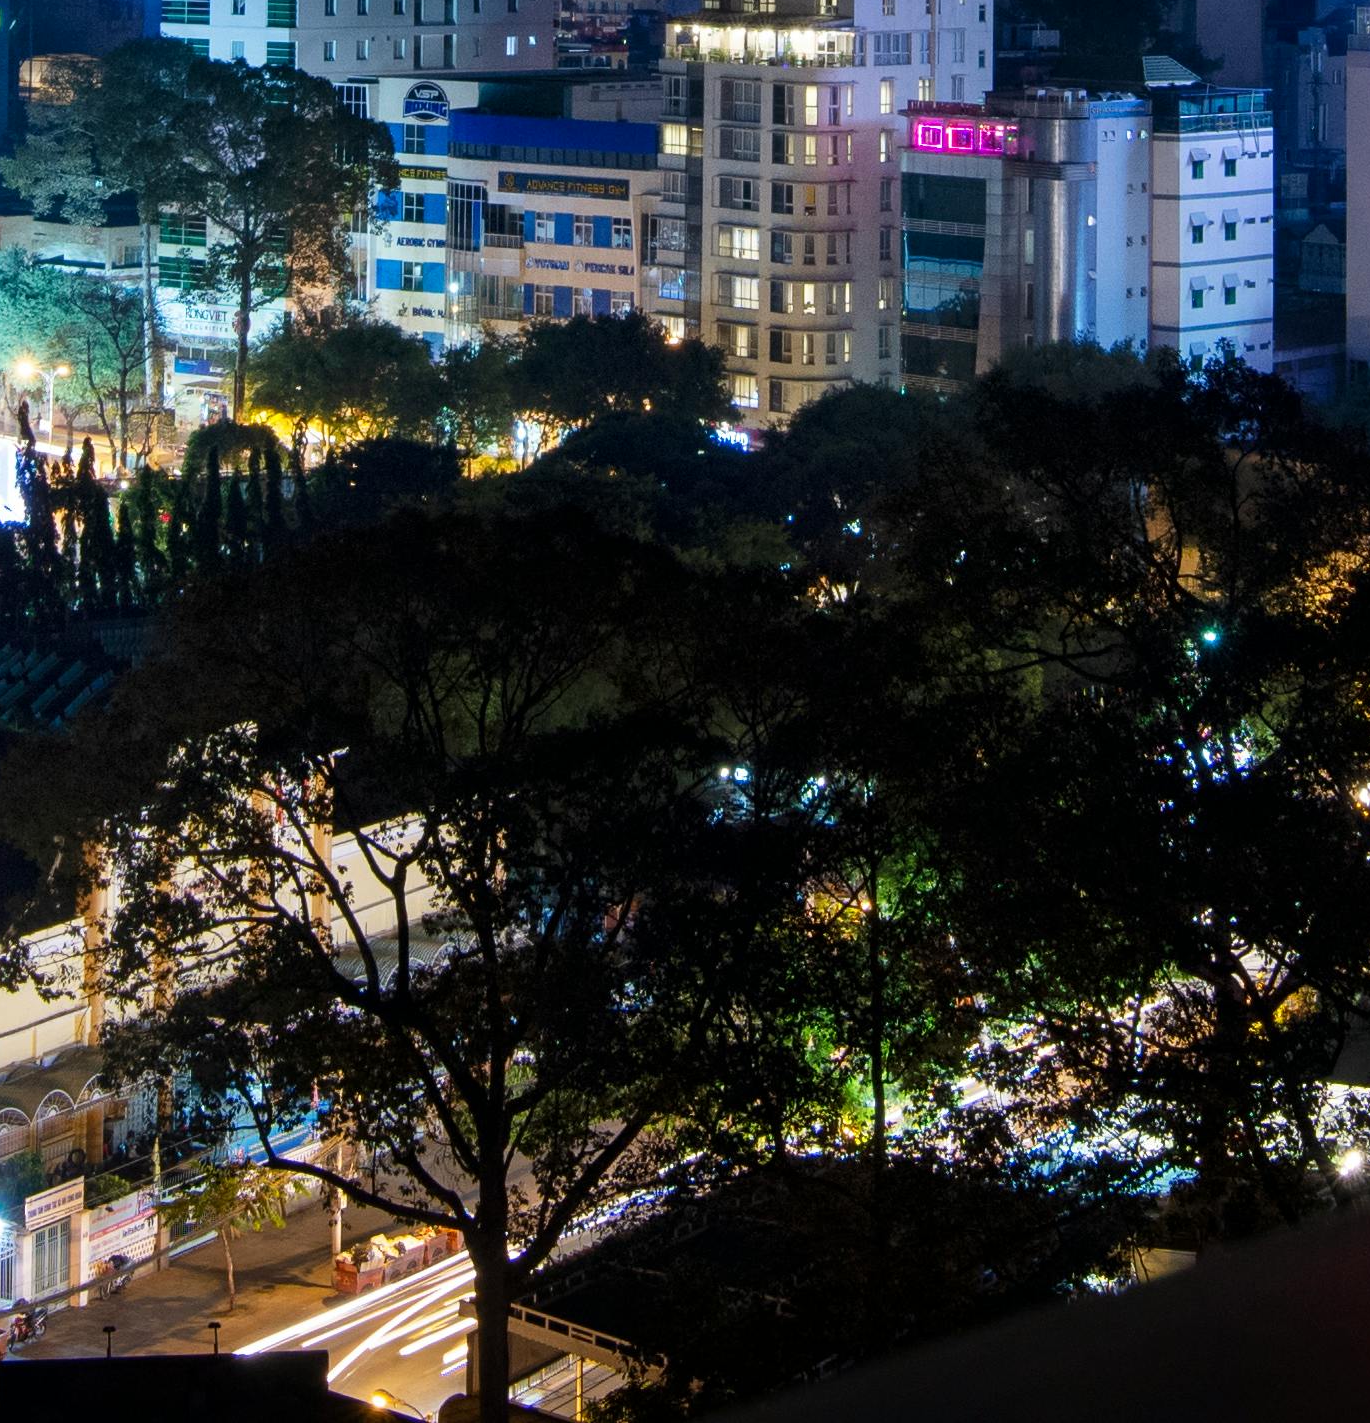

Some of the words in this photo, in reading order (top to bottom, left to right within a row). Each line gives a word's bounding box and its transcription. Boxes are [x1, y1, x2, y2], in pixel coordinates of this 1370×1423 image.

[414, 89, 439, 99] VSP
[404, 101, 448, 118] BOXING
[416, 169, 447, 179] FITNES
[527, 179, 566, 192] ADVANCE
[567, 182, 604, 194] FITNESS
[608, 184, 626, 195] GYM
[397, 236, 426, 247] AEROBIC
[617, 265, 635, 276] SILA
